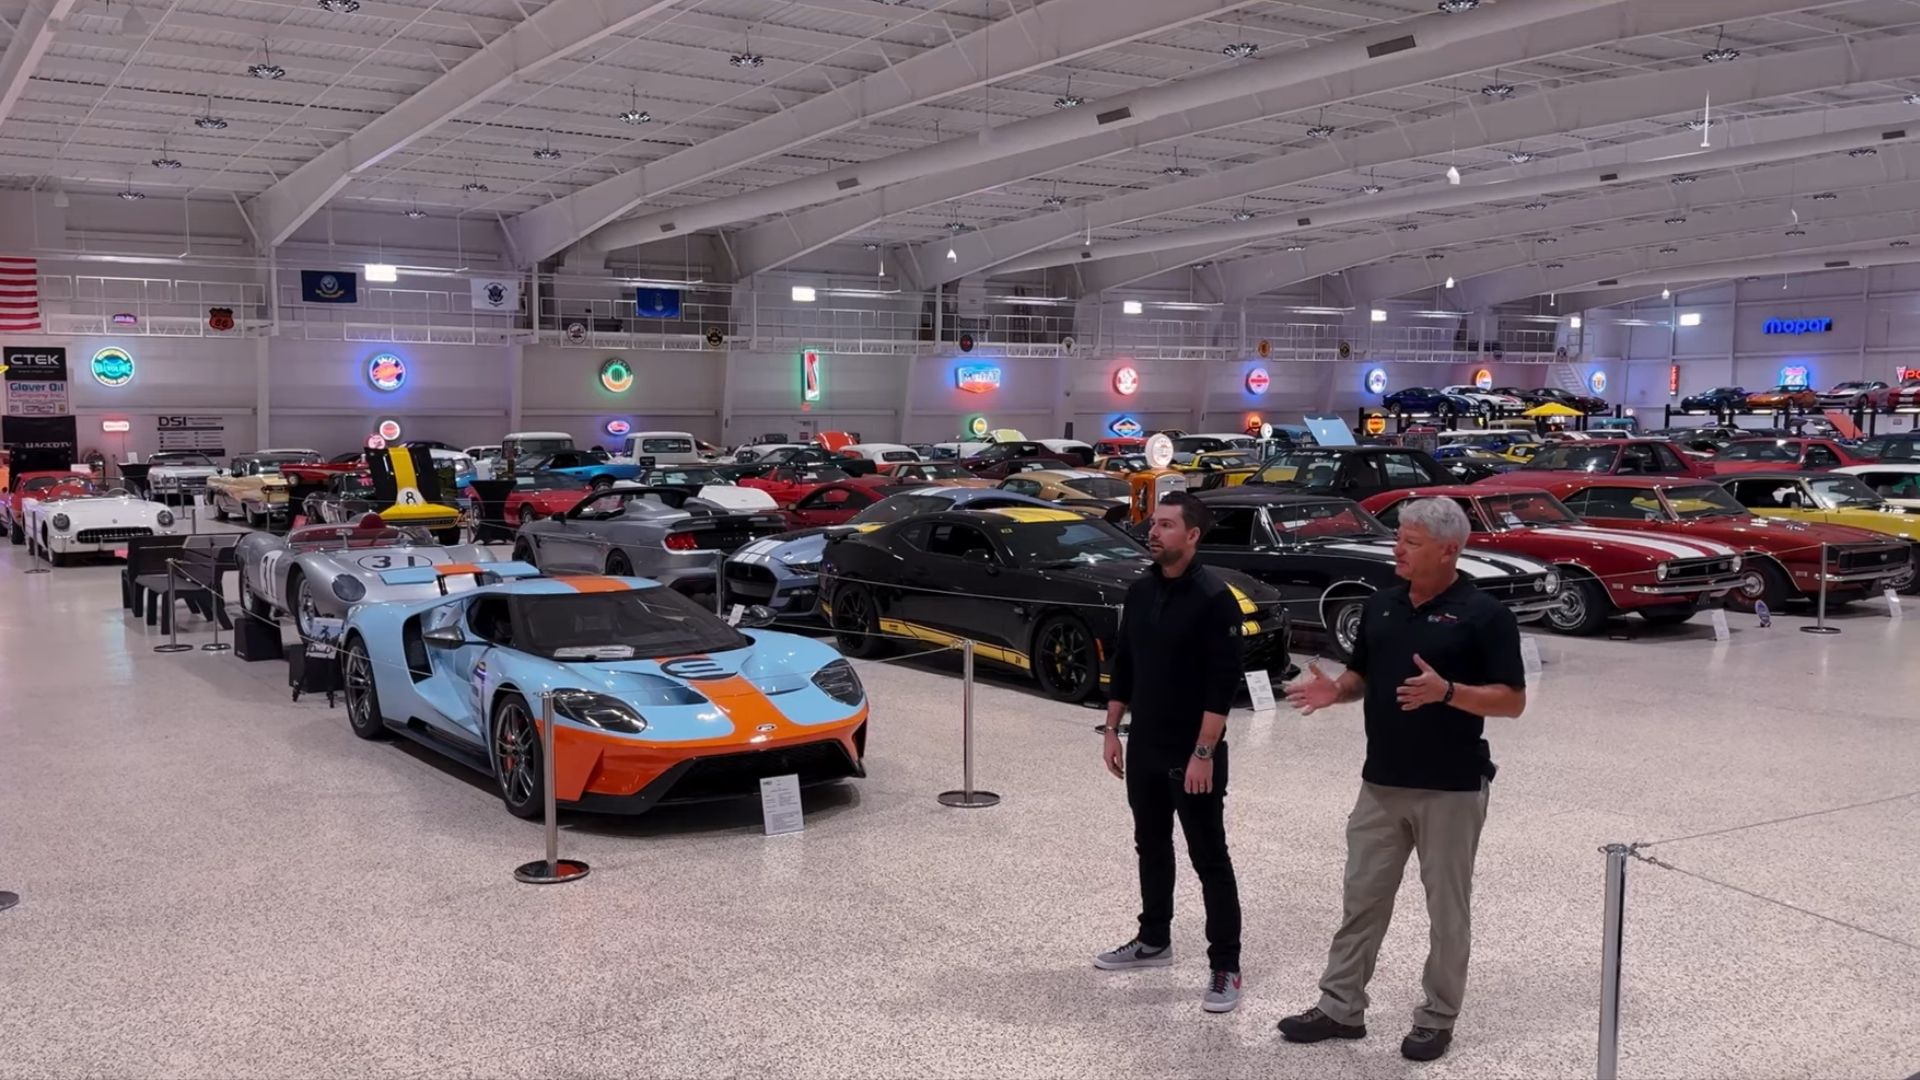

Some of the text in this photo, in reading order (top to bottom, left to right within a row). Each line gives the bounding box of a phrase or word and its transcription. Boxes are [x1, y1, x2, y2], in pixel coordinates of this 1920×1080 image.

[10, 354, 59, 365] CTEK
[10, 382, 65, 392] Glover Oil
[158, 416, 187, 427] DSI
[406, 491, 416, 504] 8
[371, 555, 416, 569] 31
